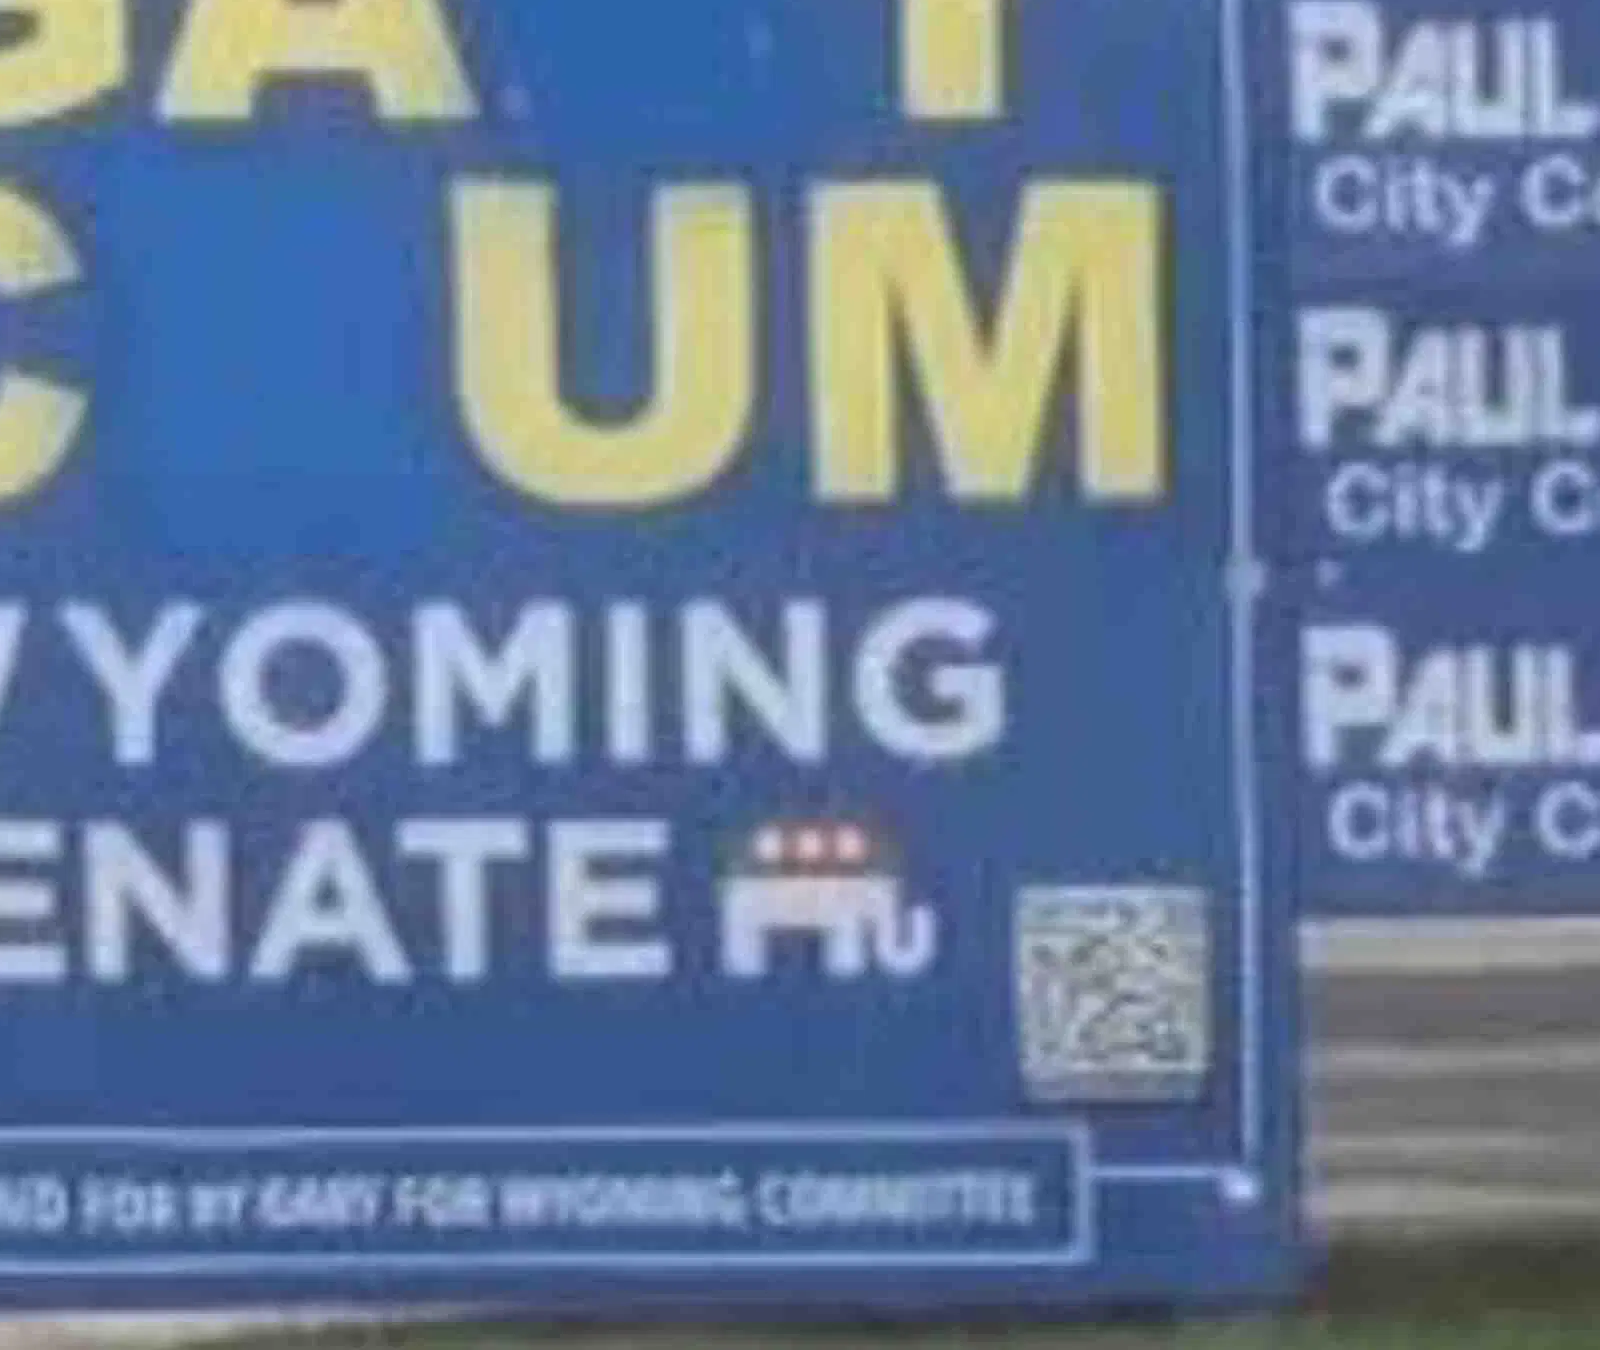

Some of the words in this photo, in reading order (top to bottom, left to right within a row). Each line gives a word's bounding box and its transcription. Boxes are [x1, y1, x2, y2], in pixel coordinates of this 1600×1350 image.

[1313, 154, 1496, 248] City
[1324, 460, 1504, 553] City
[1326, 781, 1507, 877] City
